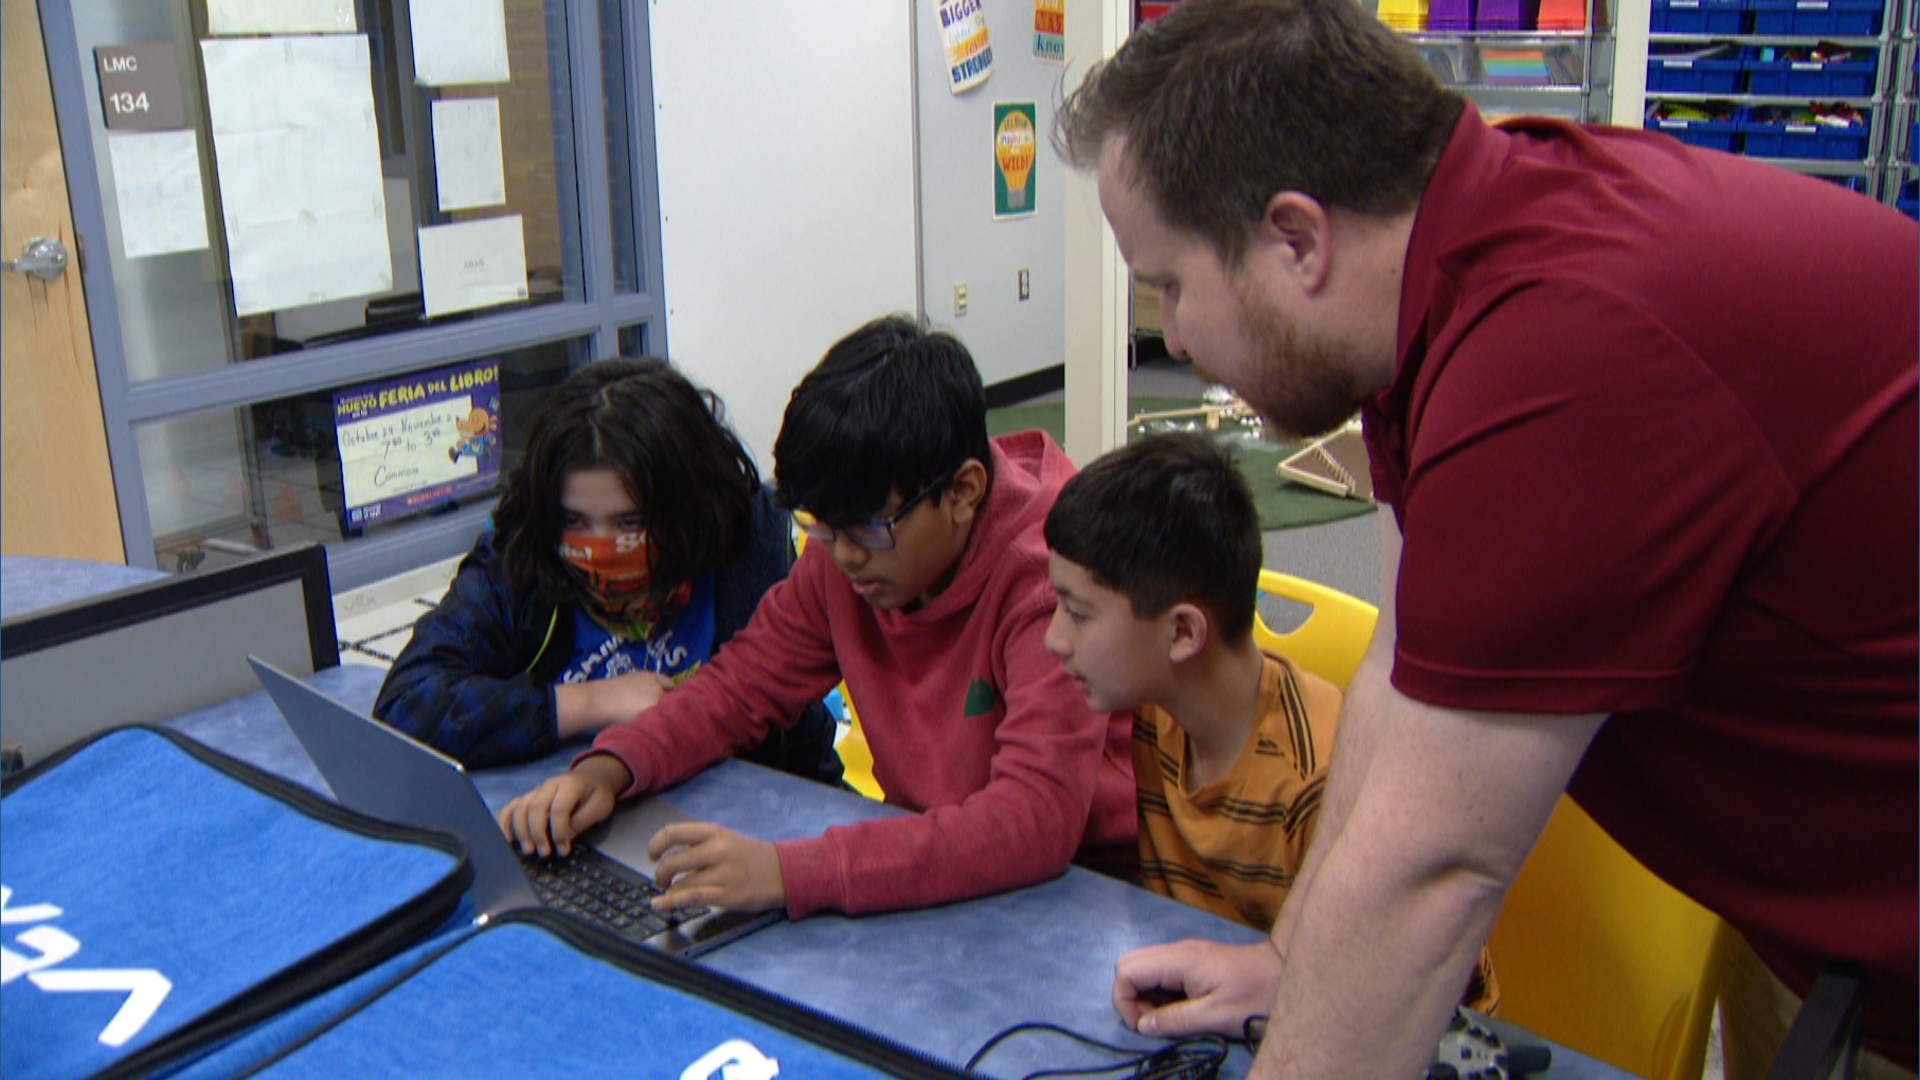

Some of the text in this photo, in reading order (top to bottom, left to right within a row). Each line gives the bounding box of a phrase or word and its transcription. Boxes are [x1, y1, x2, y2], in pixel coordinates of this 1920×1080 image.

[1036, 11, 1064, 34] NEV
[103, 56, 138, 72] LMC
[110, 91, 150, 114] 134
[337, 398, 377, 416] NUEVO
[379, 383, 426, 410] FERIA
[428, 381, 447, 395] DEL
[450, 365, 499, 392] LIBRO!
